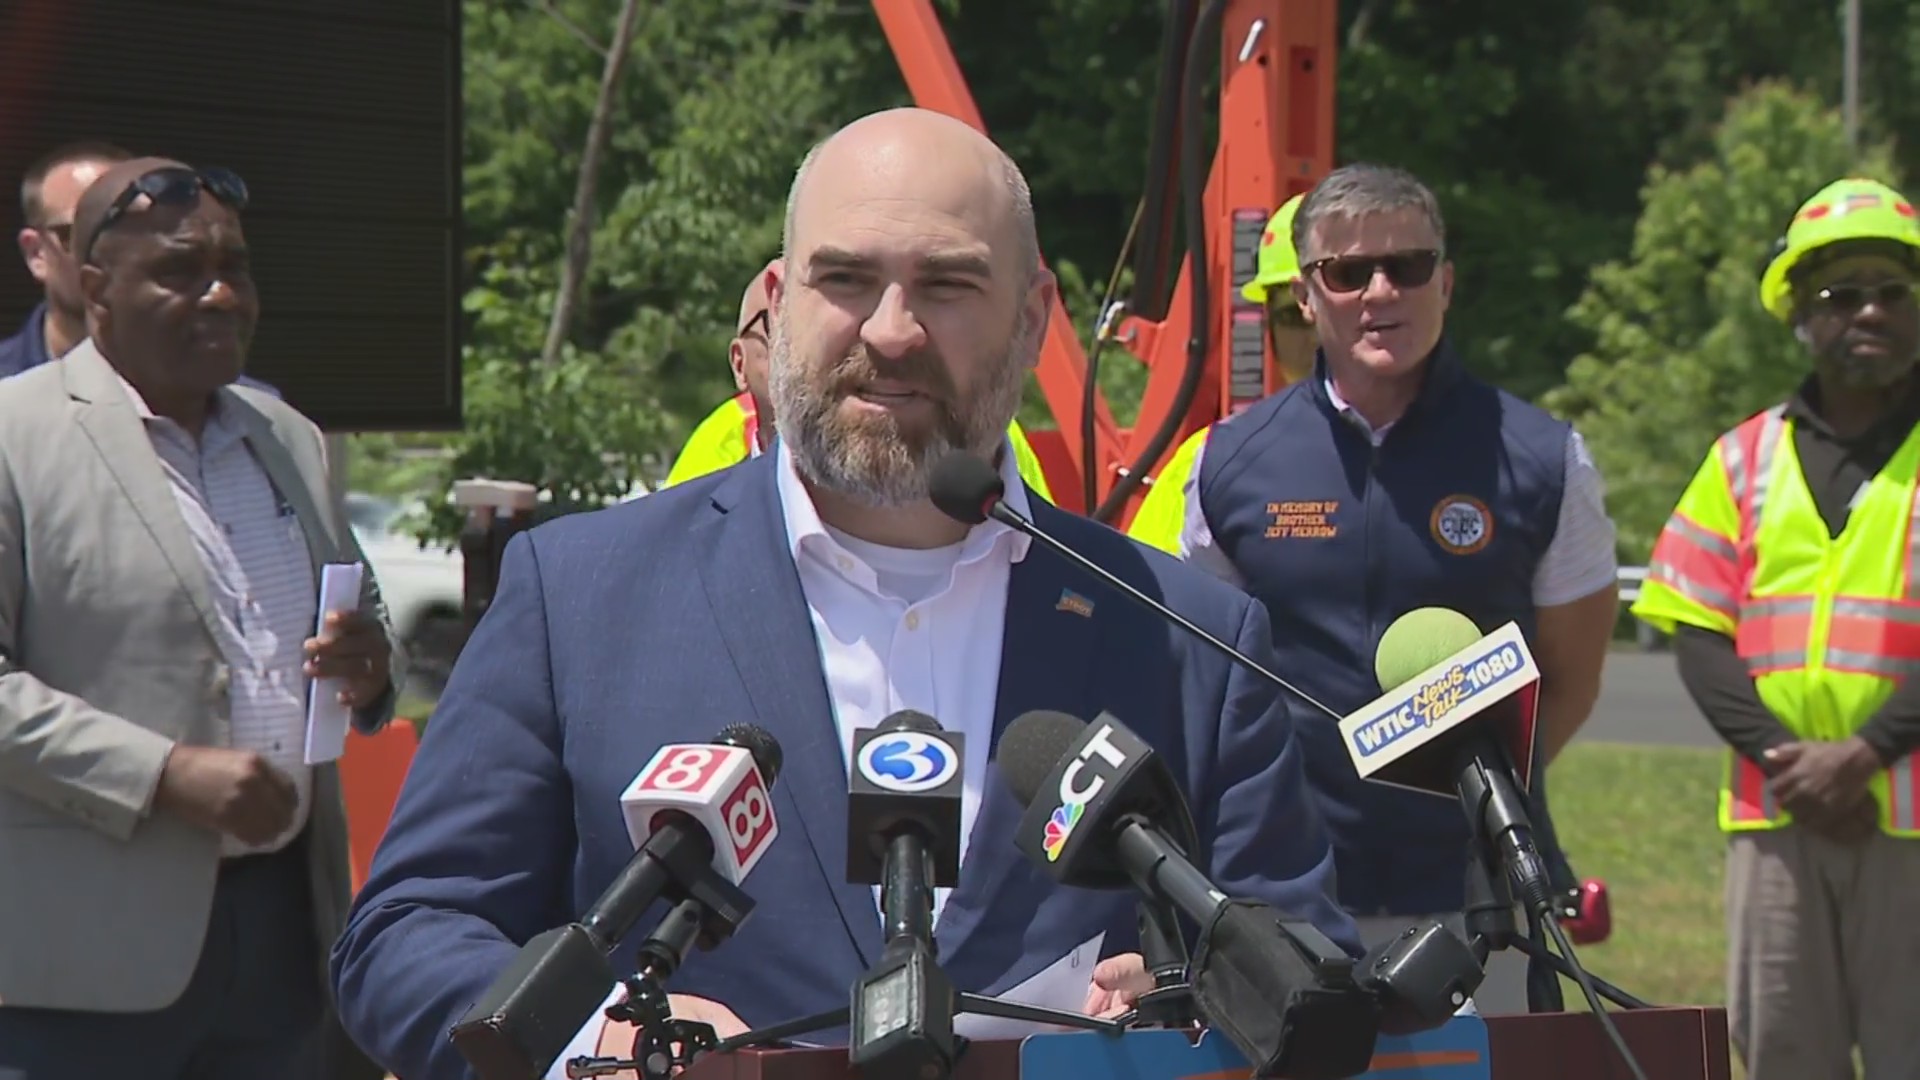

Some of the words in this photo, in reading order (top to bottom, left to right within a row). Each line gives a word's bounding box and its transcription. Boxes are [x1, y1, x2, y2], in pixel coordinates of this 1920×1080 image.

[1266, 502, 1279, 513] IN
[1280, 501, 1322, 513] MEMORY
[1324, 501, 1339, 513] OF
[1276, 514, 1325, 525] BROTHER
[1264, 526, 1289, 537] JEFF
[1357, 705, 1416, 752] WTIC
[1412, 665, 1466, 714] News
[1466, 647, 1517, 689] 1080
[1418, 688, 1472, 728] Talk
[653, 748, 712, 790] 8
[1059, 724, 1127, 804] CT
[729, 785, 767, 850] 8
